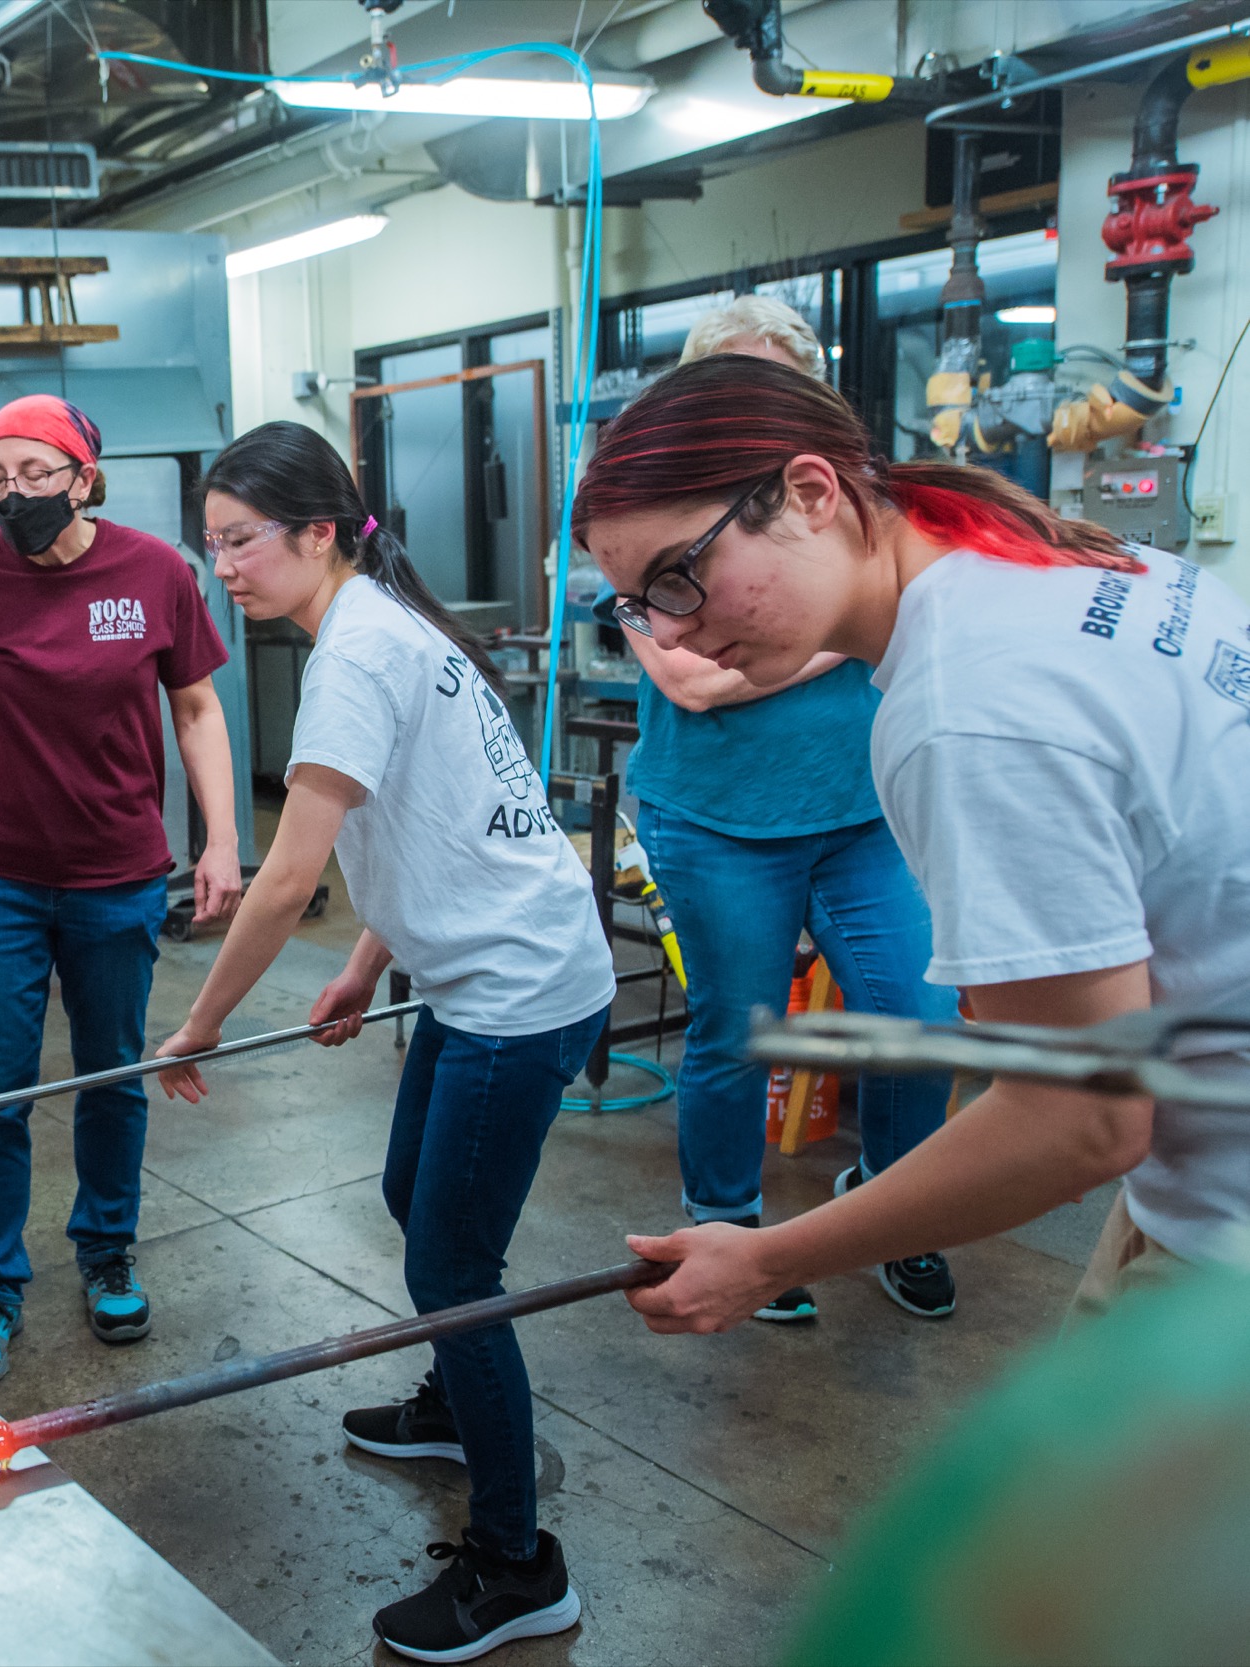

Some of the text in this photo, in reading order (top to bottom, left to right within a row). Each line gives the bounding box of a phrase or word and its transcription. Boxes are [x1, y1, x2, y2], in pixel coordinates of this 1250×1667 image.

[837, 84, 867, 99] GAS
[88, 598, 146, 625] NOCA
[89, 620, 146, 634] GLASS SCHOOL
[435, 646, 468, 698] UN
